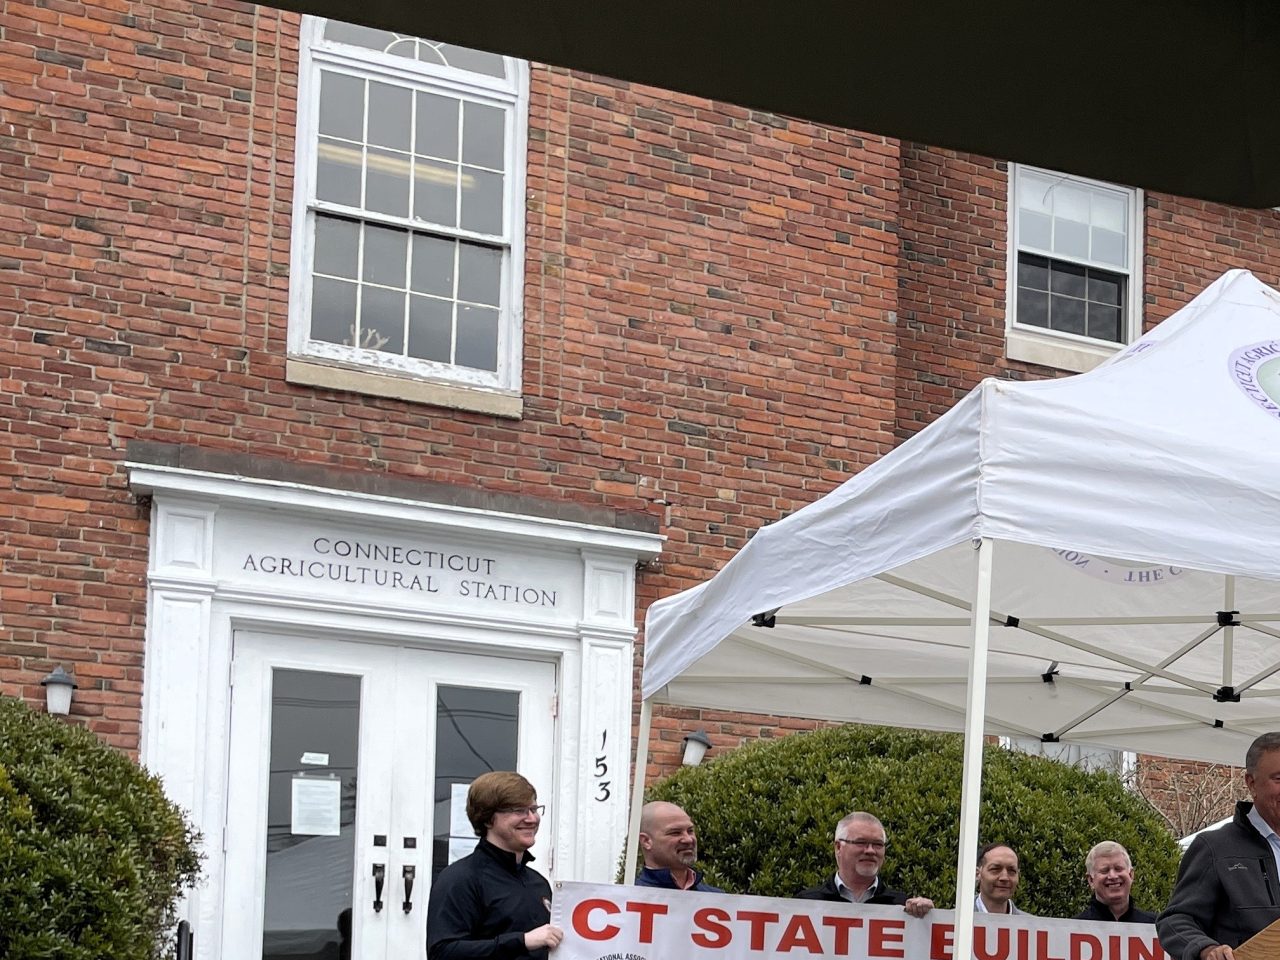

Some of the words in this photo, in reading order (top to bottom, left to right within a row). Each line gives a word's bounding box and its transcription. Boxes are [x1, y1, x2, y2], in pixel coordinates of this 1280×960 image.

[242, 554, 439, 594] AGRICULTURAL
[459, 579, 557, 607] STATION
[313, 537, 496, 575] CONNECTICUT
[593, 728, 611, 803] 153
[571, 898, 669, 944] CT
[691, 907, 906, 959] STATE
